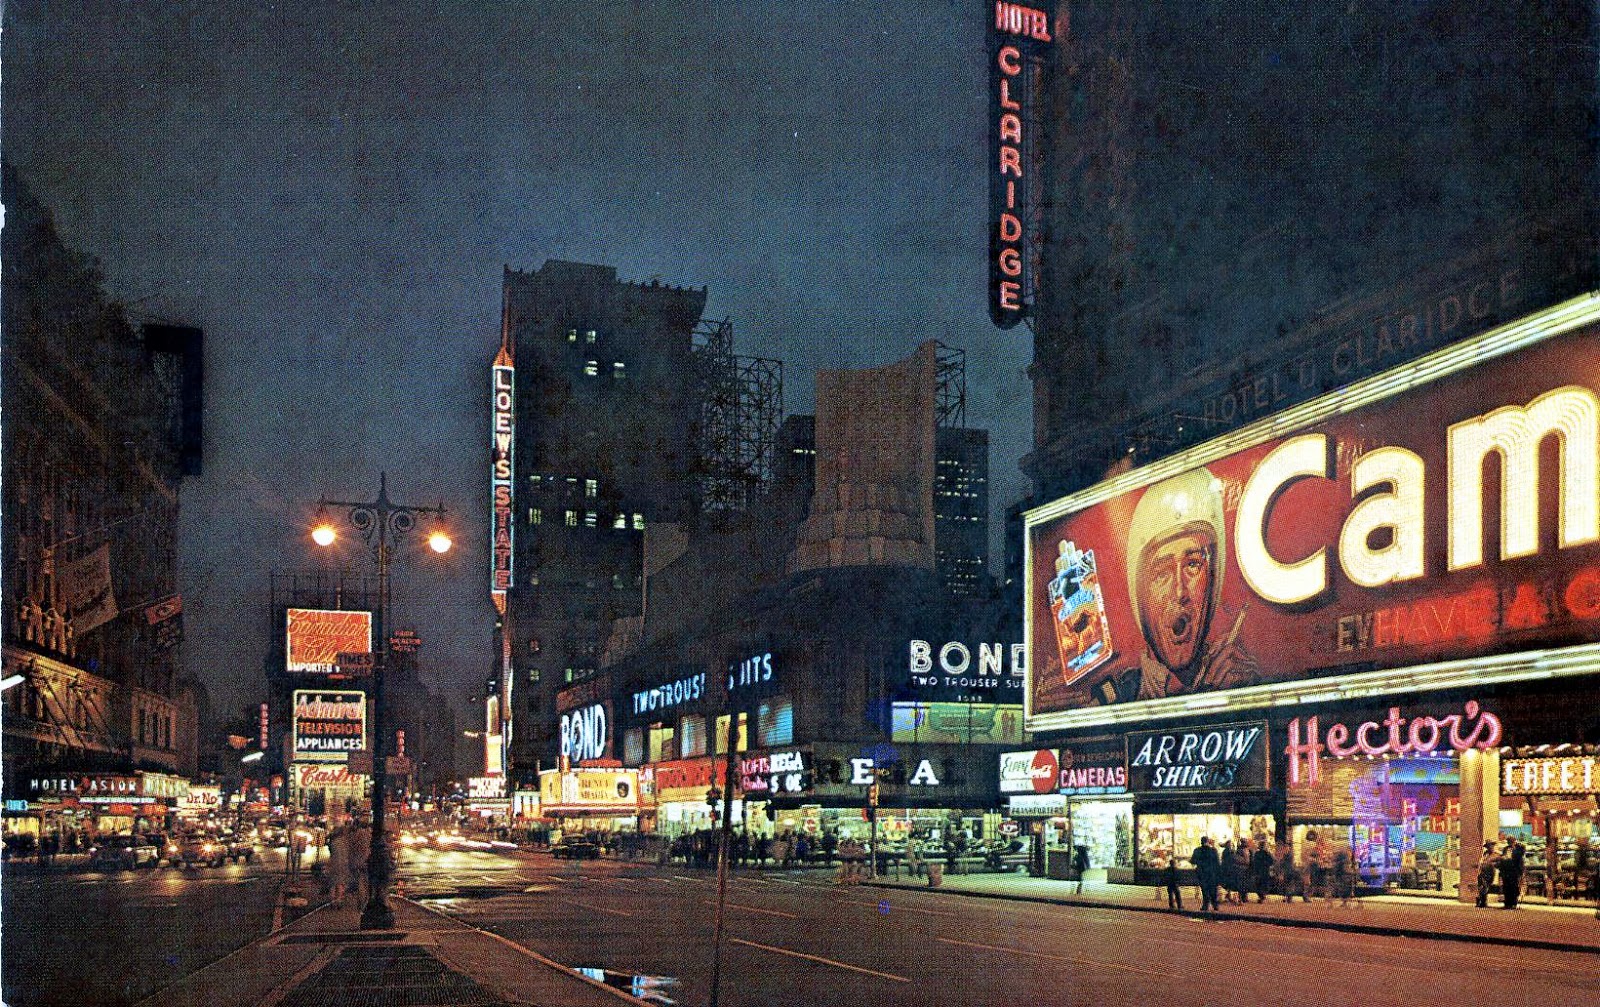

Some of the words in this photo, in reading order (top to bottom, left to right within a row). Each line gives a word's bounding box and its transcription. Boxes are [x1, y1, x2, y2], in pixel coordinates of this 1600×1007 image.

[995, 1, 1051, 42] HOTEL
[998, 46, 1021, 310] CLARIDGE
[495, 486, 511, 589] STATE
[338, 653, 370, 665] TIMES
[910, 639, 1024, 676] BOND
[912, 676, 938, 686] TWO
[945, 677, 998, 688] TROUSER
[297, 694, 365, 718] Admiral
[633, 689, 657, 715] TWO
[299, 722, 362, 735] TELEVISION
[560, 703, 606, 762] BOND
[298, 738, 363, 750] APPLIANCES
[1131, 727, 1261, 767] ARROW
[1284, 700, 1502, 789] Hector's
[31, 779, 77, 791] HOTEL
[89, 779, 136, 791] ASTOR
[1060, 766, 1125, 788] CAMERAS
